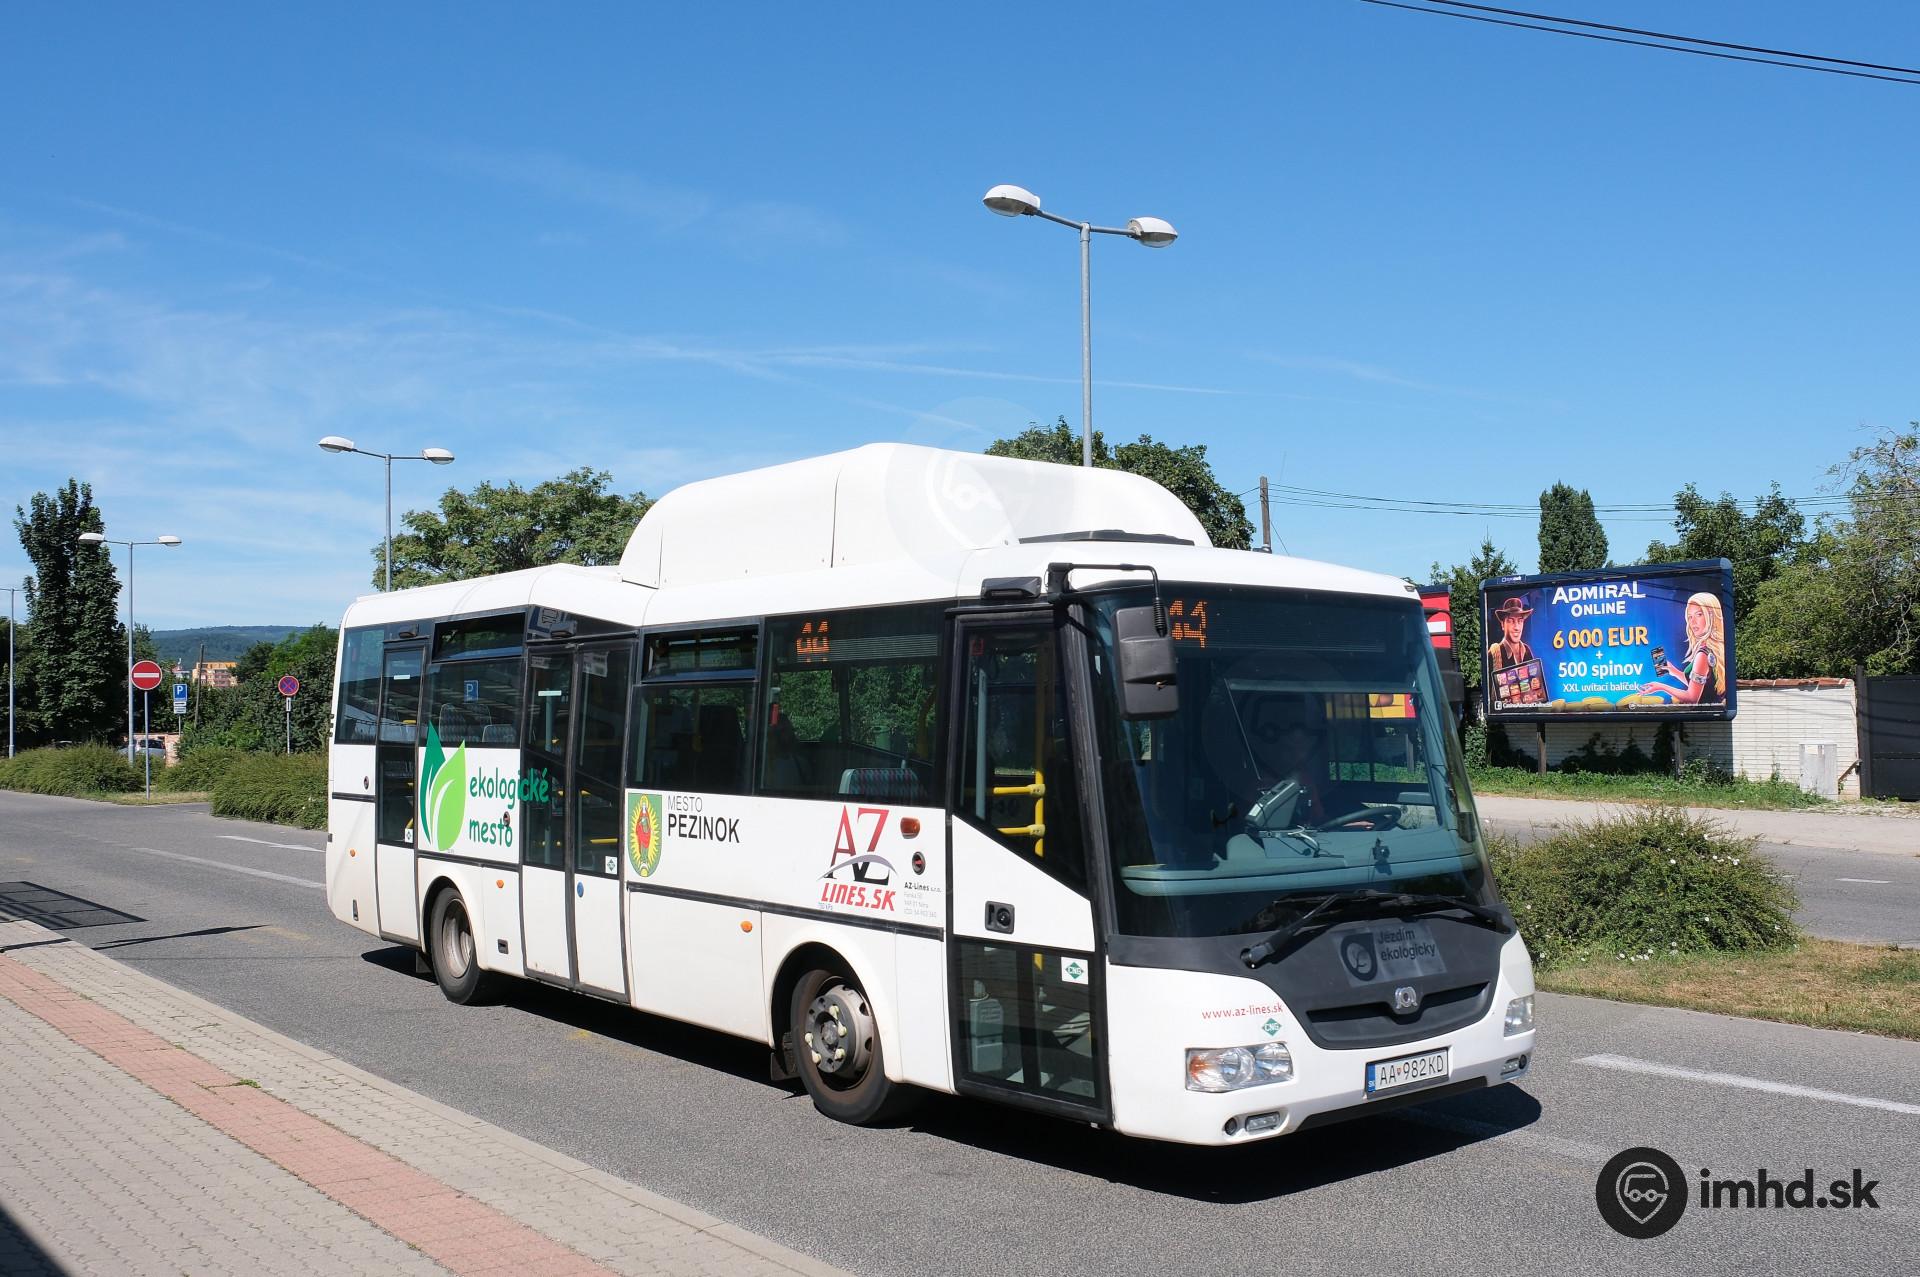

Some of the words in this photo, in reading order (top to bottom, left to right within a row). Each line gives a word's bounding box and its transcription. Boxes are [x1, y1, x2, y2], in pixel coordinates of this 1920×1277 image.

[1551, 581, 1647, 605] ADMIRAL
[1570, 600, 1627, 618] ONLINE
[1607, 625, 1650, 647] EUR
[1558, 661, 1588, 678] 500
[1591, 659, 1644, 680] spinov
[177, 685, 183, 695] P
[466, 683, 473, 697] P
[1562, 683, 1580, 693] XXL
[469, 766, 549, 810] ekologické
[667, 795, 703, 813] MESTO
[469, 817, 513, 848] mesto
[667, 813, 740, 844] PEZINOK
[904, 881, 930, 892] AZ-Lines
[820, 882, 897, 912] LINES.SK
[1377, 927, 1416, 945] Jezdím
[1379, 942, 1436, 961] ekologicky
[1201, 1002, 1284, 1020] www.az-lines.sk
